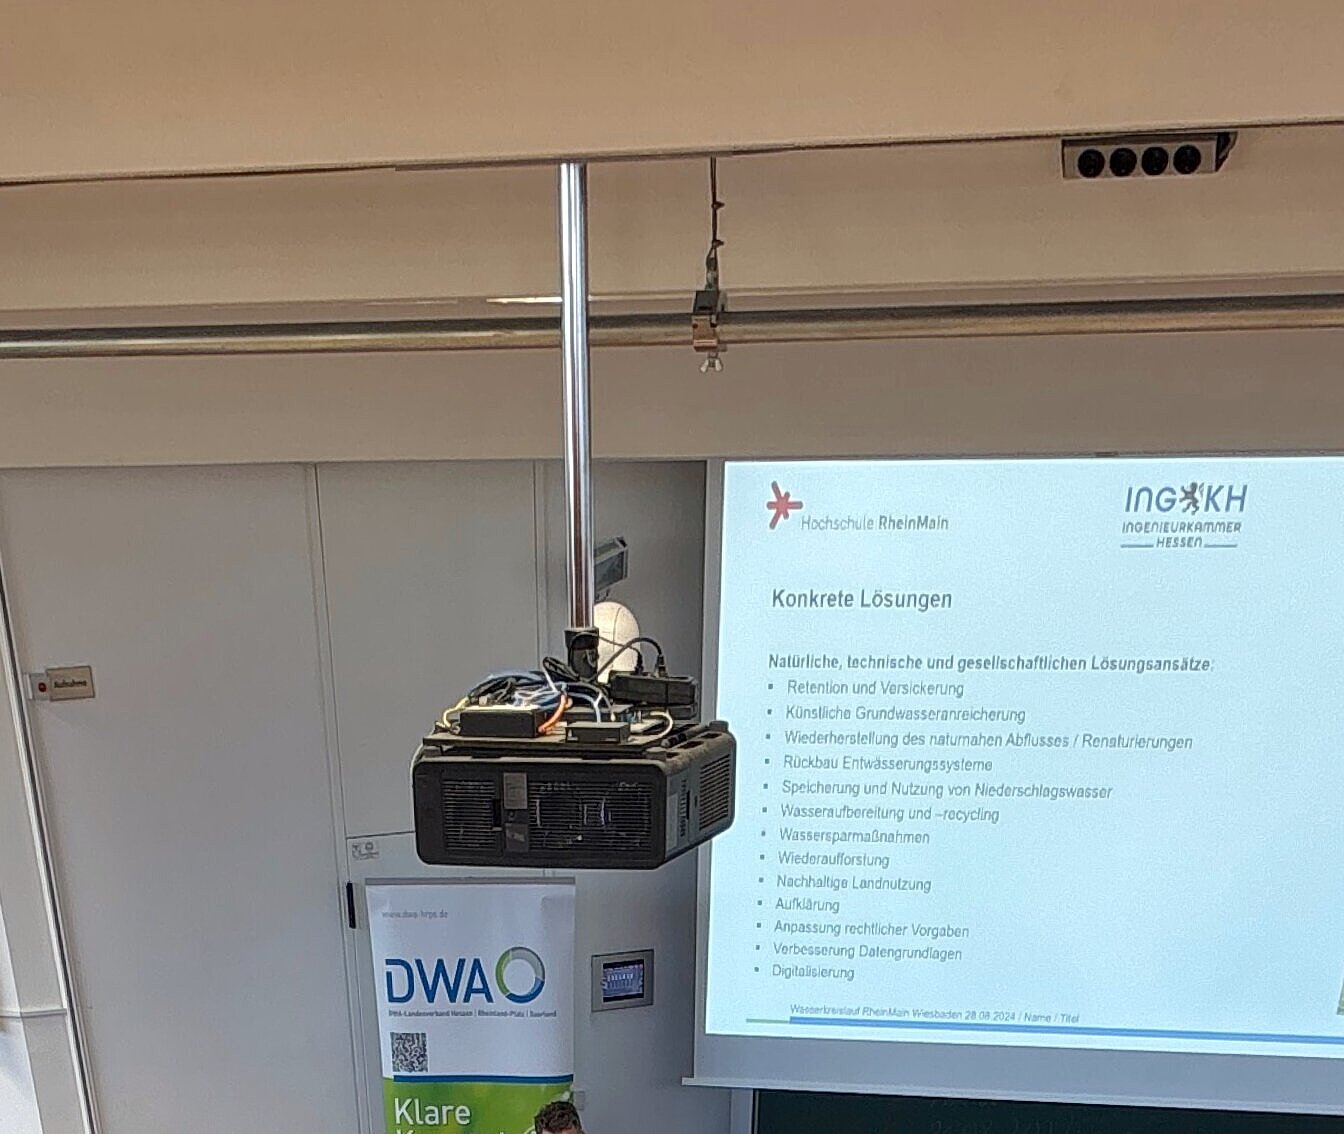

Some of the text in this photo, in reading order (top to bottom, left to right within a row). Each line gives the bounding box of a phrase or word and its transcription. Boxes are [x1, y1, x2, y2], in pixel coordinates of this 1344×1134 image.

[801, 515, 949, 530] Hochschule RheinMain
[772, 589, 952, 612] Konkrete Lösungen
[769, 654, 842, 673] Natürliche,
[847, 655, 922, 671] technische
[927, 656, 953, 671] und
[957, 655, 1087, 673] gesellschaftlichen
[788, 680, 964, 698] Retention und Versickerung
[786, 705, 1026, 725] Künstliche Grundwasseranreicherung
[785, 730, 898, 749] Wiederherstellung
[903, 733, 925, 746] des
[929, 733, 1001, 748] naturnahen
[1005, 733, 1069, 749] Abflusses
[1082, 734, 1193, 752] Renaturierungen
[783, 755, 992, 774] Rückbau Entwässerungssysteme
[782, 780, 1113, 801] Speicherung und Nutzung von Niederschlagswasser
[781, 804, 903, 822] Wasseraufbereitung
[908, 806, 931, 820] und
[779, 827, 929, 846] Wassersparmaßnahmen
[778, 851, 890, 869] Wiederaufforstung
[777, 875, 932, 894] Nachhaltige Landnutzung
[775, 898, 840, 914] Aufklärung
[774, 920, 969, 940] Anpassung rechtlicher Vorgaben
[773, 942, 962, 962] Verbesserung Datengrundlagen
[385, 958, 494, 1003] DWA
[772, 964, 855, 982] Digitalisierung
[394, 1098, 471, 1125] Klare
